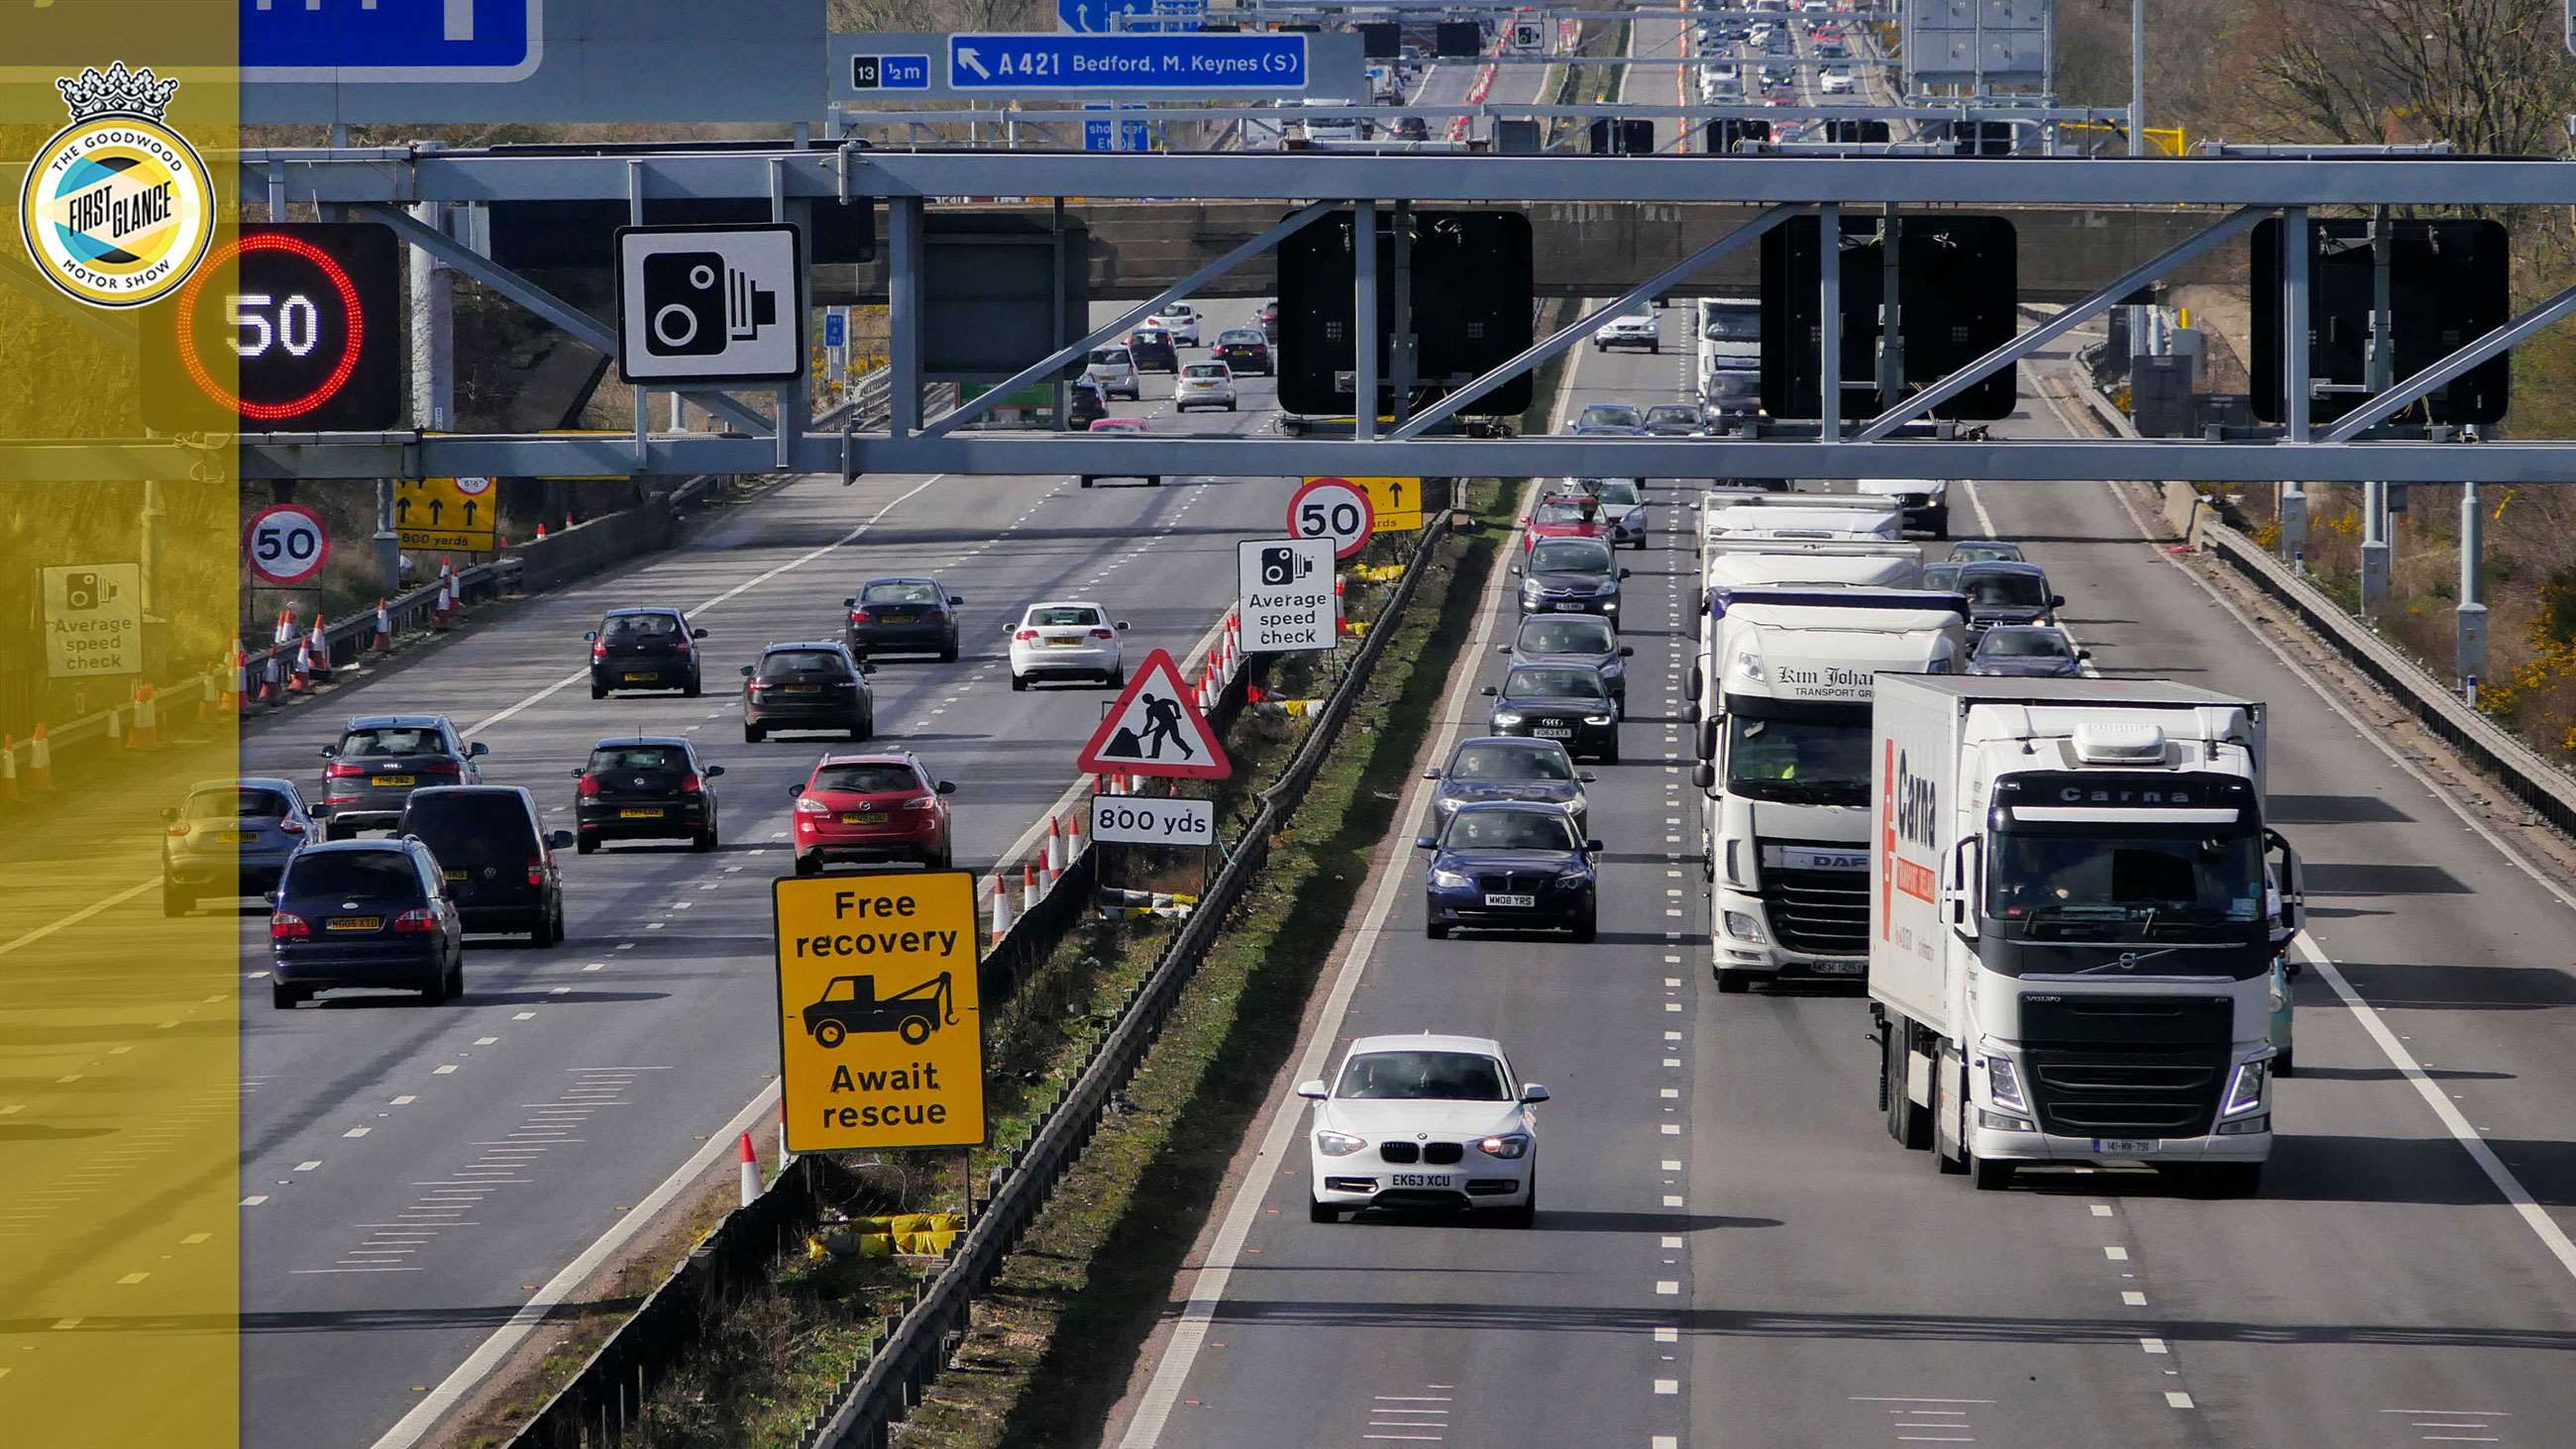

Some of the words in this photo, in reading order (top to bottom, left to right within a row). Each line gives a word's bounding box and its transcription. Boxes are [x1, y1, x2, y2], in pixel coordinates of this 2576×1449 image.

[1073, 54, 1156, 73] Bedford,
[1162, 55, 1186, 71] M.
[857, 66, 875, 80] 13
[904, 66, 920, 80] m
[226, 294, 318, 358] 50
[1302, 503, 1360, 536] 50
[257, 528, 315, 561] 50
[1249, 593, 1328, 609] Average
[55, 618, 132, 633] Average
[1260, 610, 1316, 628] speed
[66, 635, 121, 653] speed
[1260, 629, 1317, 645] check
[66, 654, 122, 670] check
[1776, 666, 1817, 683] Kim
[1794, 687, 1856, 698] TRANSPORT
[1898, 748, 1936, 851] Carna
[2060, 786, 2190, 803] Carna
[1099, 808, 1155, 830] 800
[1163, 812, 1207, 835] yds
[1813, 856, 1868, 868] DAF
[834, 890, 916, 919] Free
[1513, 896, 1532, 906] YRS
[796, 930, 957, 959] recovery
[829, 1062, 940, 1093] Await
[823, 1102, 947, 1129] rescue
[1392, 1174, 1424, 1187] EK63
[1427, 1175, 1450, 1187] XCU
